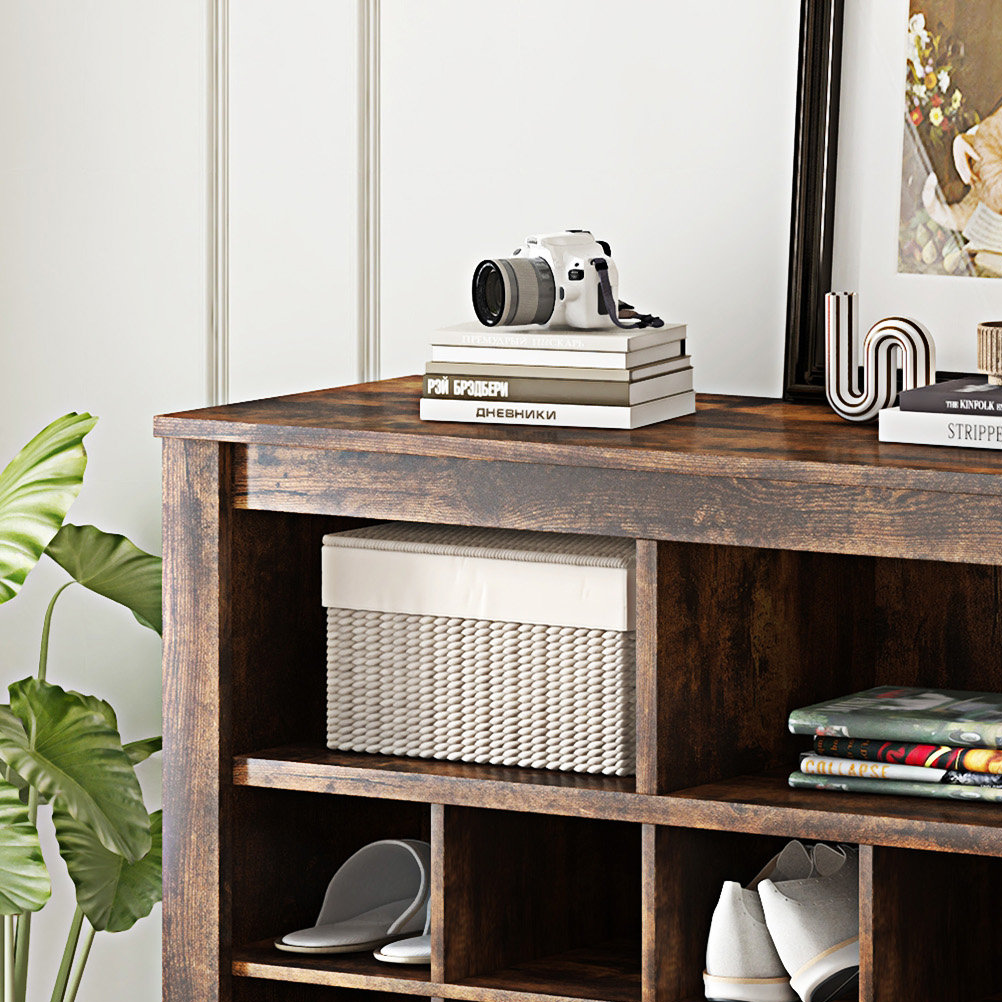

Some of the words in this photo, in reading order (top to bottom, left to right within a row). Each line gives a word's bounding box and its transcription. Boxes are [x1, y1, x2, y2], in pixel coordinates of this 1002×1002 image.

[427, 376, 449, 395] РЭЙ
[453, 380, 509, 398] БРЭДБЕРИ
[945, 400, 959, 409] THE
[960, 399, 995, 411] KINFOLK
[475, 407, 557, 420] ДНЕВНИКИ
[805, 759, 891, 779] COLLAPSE
